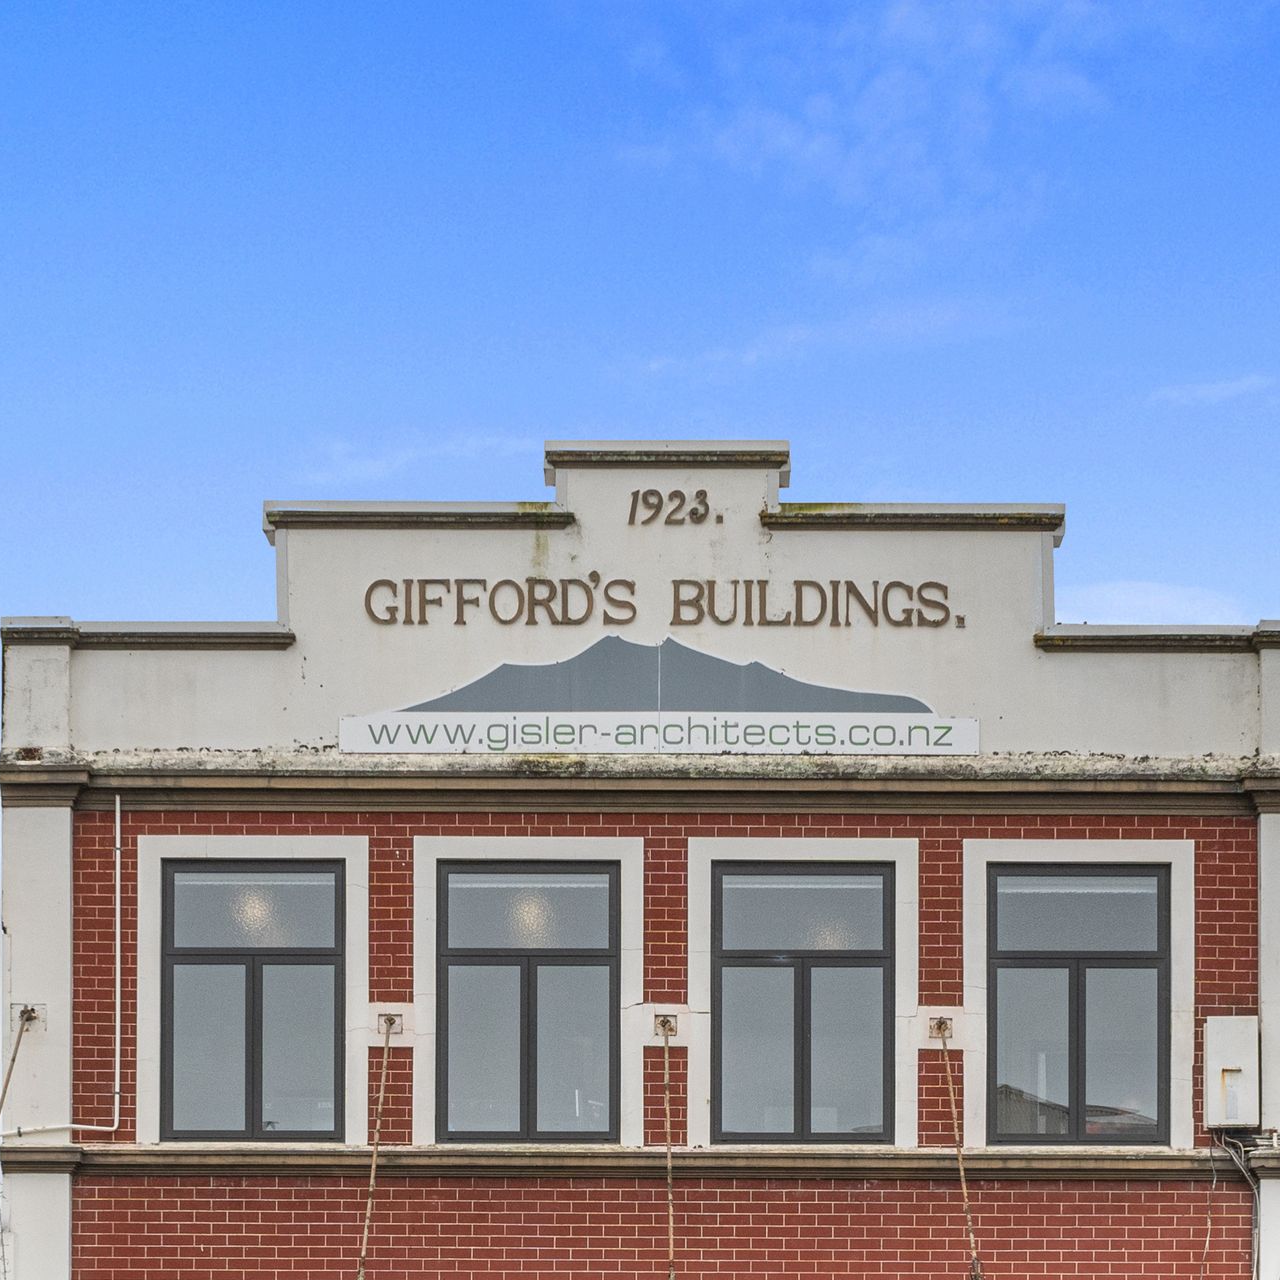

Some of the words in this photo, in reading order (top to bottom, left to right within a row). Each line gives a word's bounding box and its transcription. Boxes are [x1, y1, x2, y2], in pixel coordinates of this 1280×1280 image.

[364, 571, 637, 626] GIFFORD'S
[670, 580, 967, 628] BUILDINGS.
[367, 716, 954, 752] www.gisler-architects.co.nz
